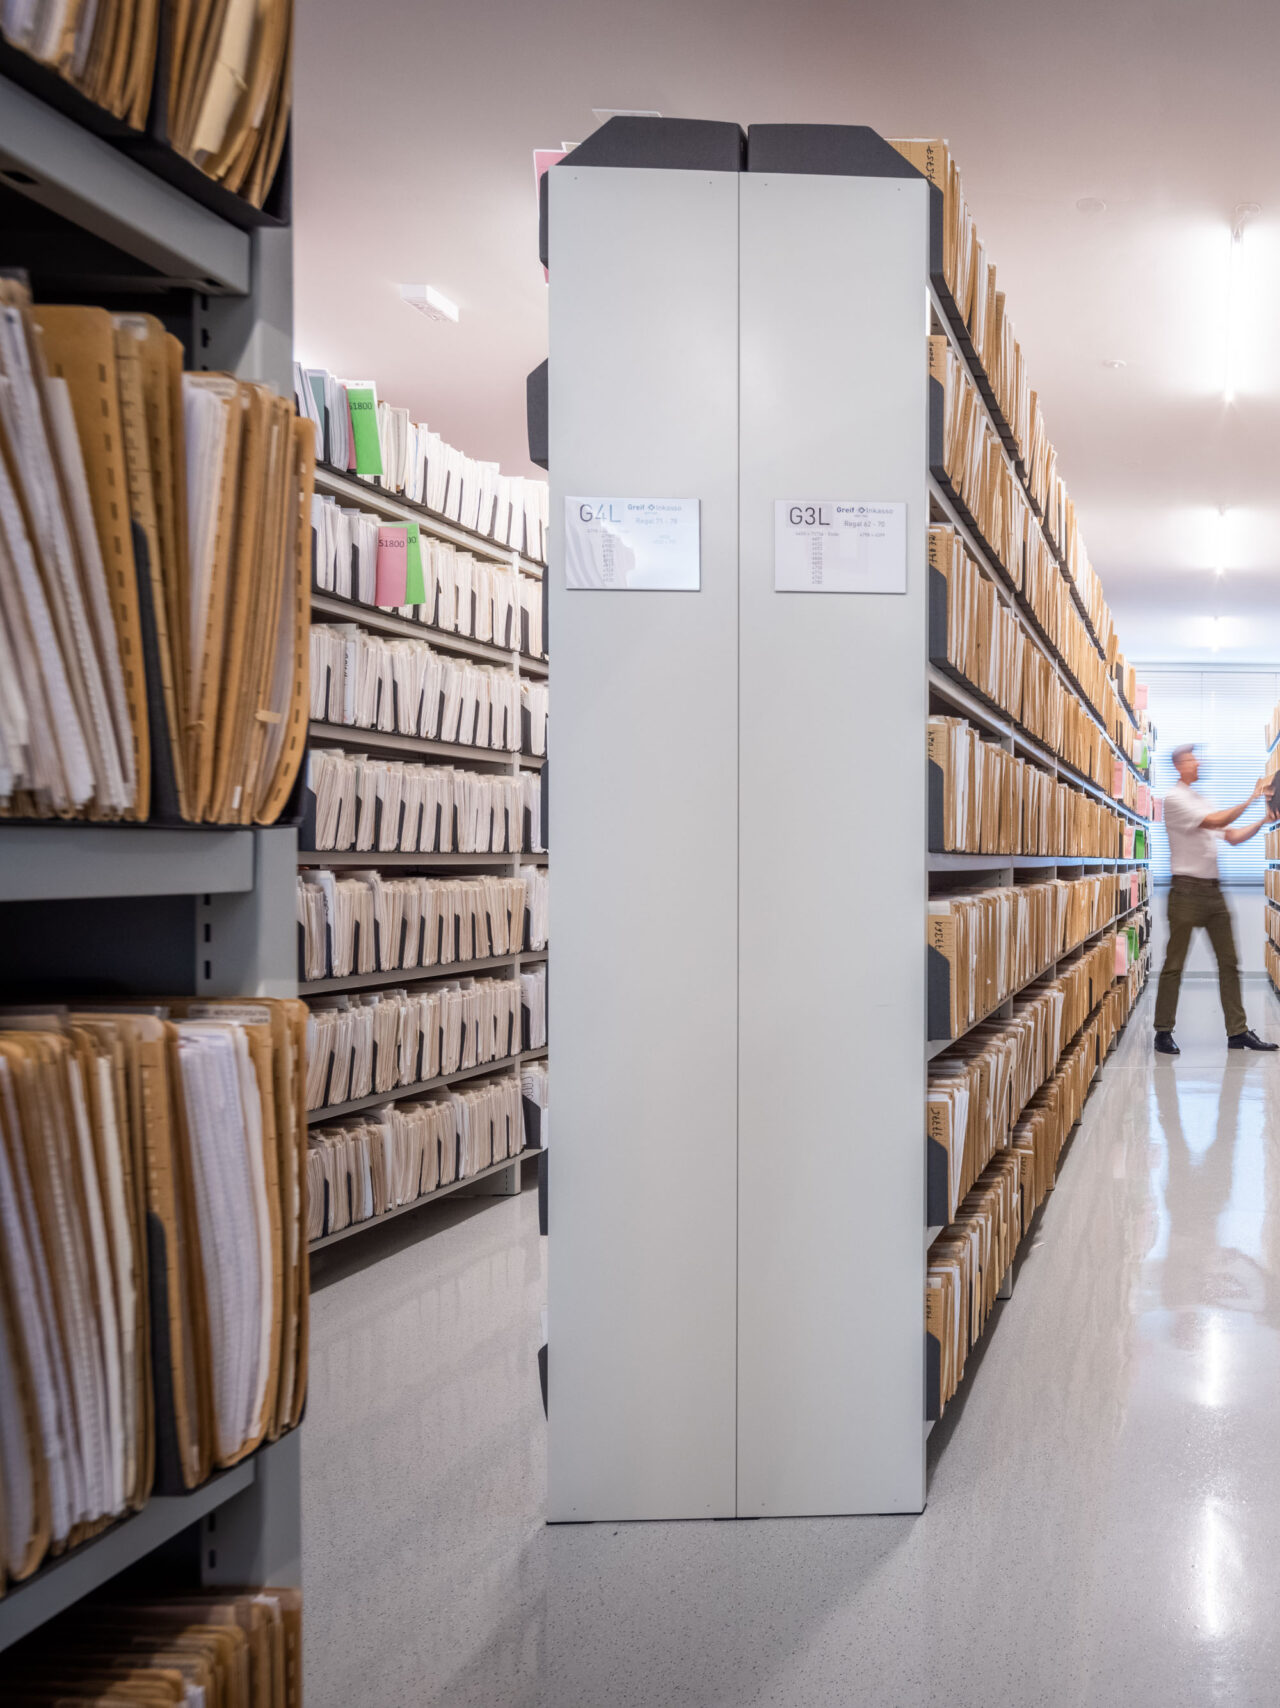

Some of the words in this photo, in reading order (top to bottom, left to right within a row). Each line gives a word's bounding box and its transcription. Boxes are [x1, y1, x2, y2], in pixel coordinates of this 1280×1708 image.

[579, 504, 622, 522] G4L
[789, 506, 831, 525] G3L
[836, 506, 855, 514] Greif
